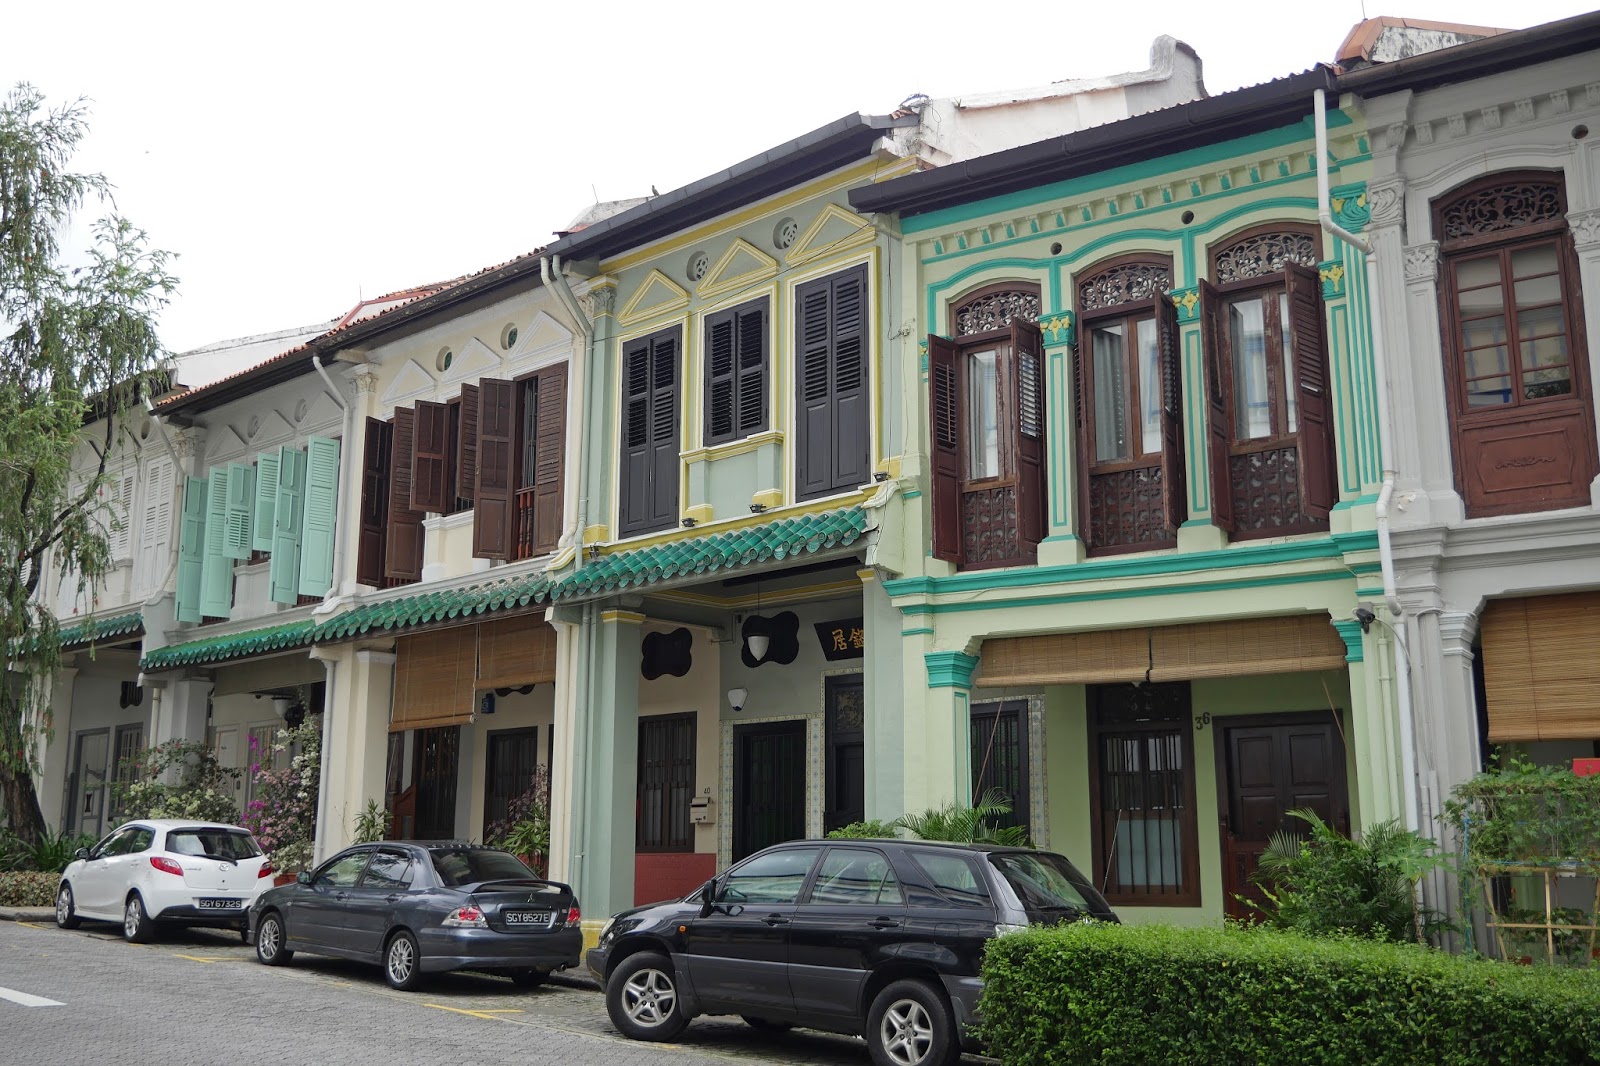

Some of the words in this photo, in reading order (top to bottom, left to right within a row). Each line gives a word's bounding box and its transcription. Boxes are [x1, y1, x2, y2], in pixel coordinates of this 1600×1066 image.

[1194, 711, 1211, 731] 36
[703, 786, 711, 795] 40
[200, 900, 241, 908] SGY6732S
[506, 913, 549, 923] SGY8527E
